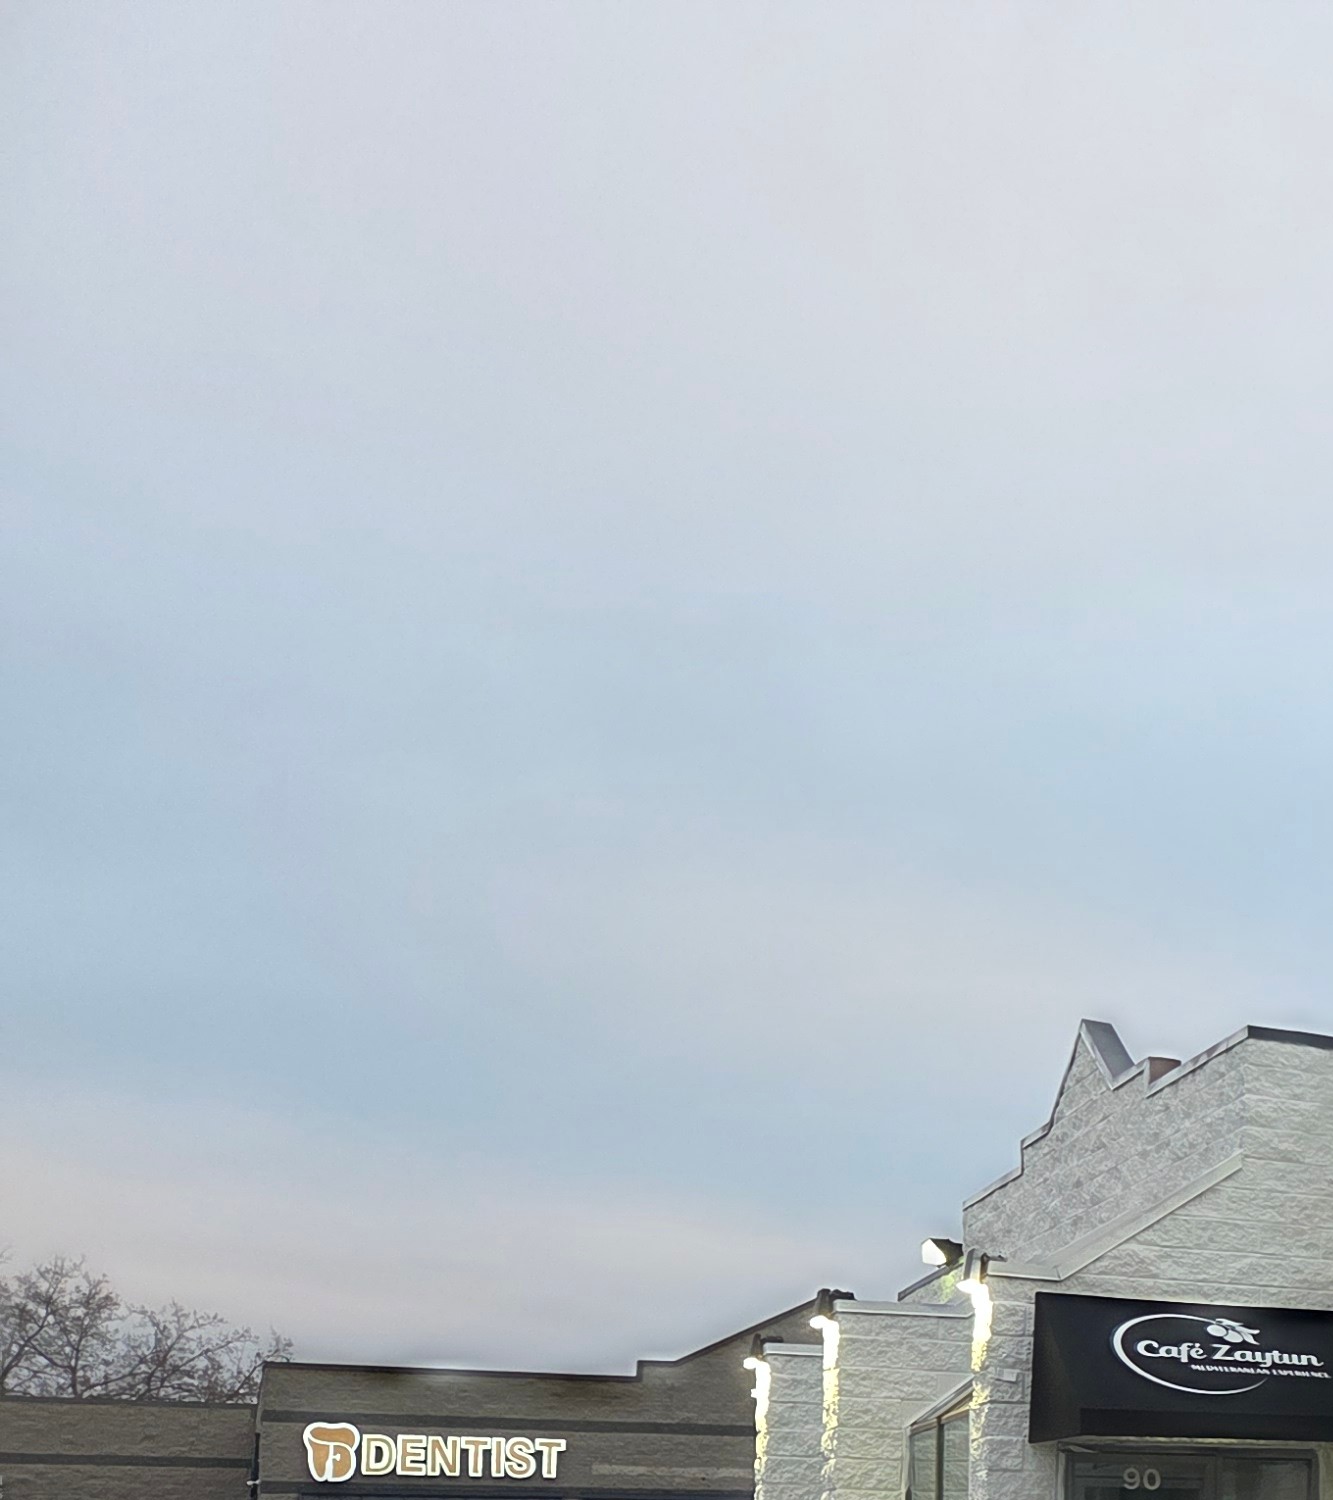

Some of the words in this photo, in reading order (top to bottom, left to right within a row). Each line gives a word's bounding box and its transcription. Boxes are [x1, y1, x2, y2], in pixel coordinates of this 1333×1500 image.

[1136, 1339, 1208, 1364] Café
[1210, 1343, 1324, 1368] Zaytun
[360, 1433, 567, 1480] DENTIST
[1122, 1467, 1161, 1491] 90
